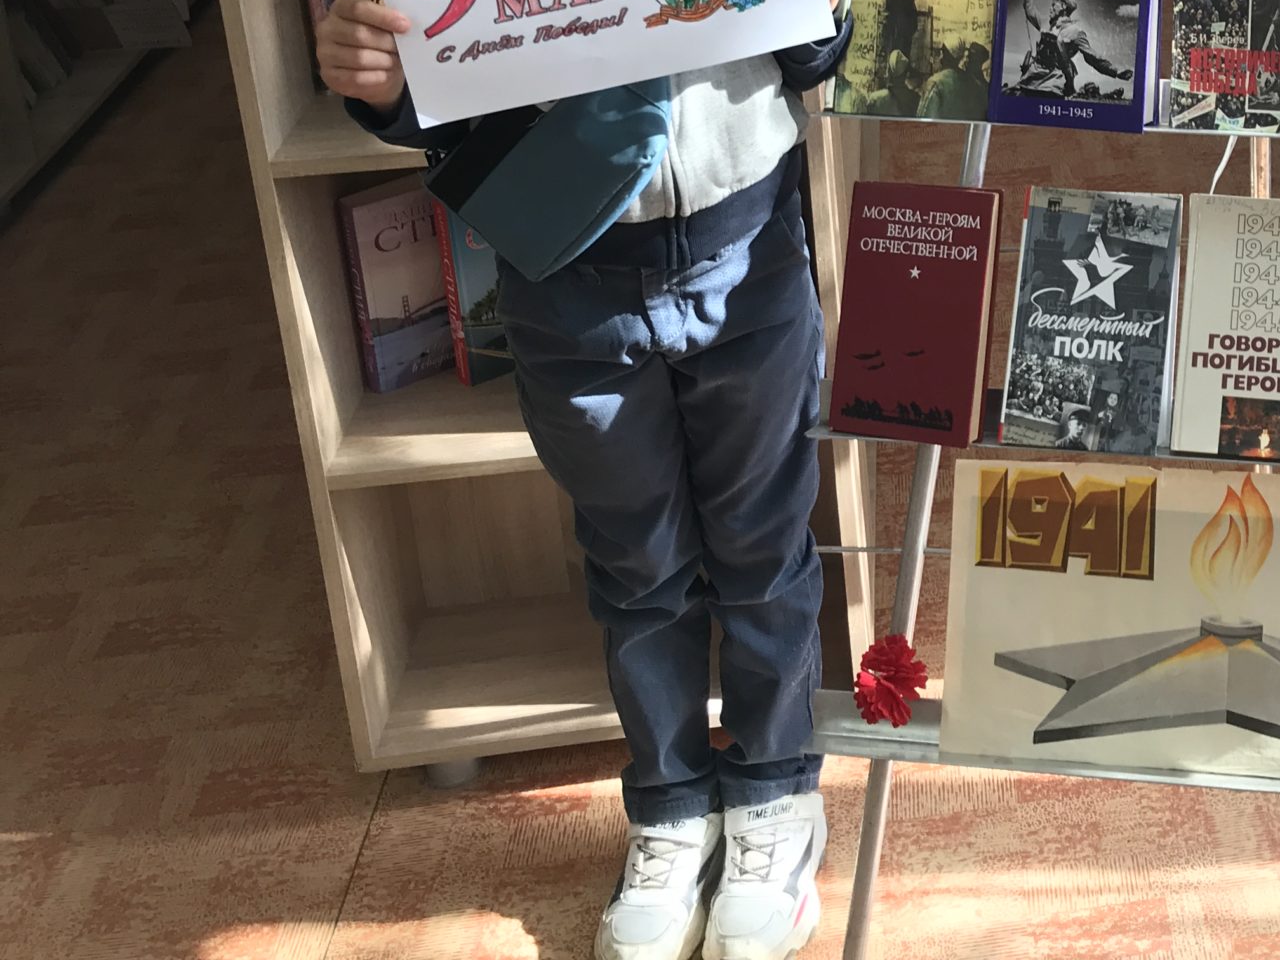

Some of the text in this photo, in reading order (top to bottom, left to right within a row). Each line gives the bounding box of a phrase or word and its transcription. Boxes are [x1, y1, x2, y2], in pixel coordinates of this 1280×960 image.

[533, 7, 628, 43] Победы!
[1189, 69, 1258, 96] ПОБЕДА
[862, 205, 981, 229] МОСКВА-ГЕРОЯМ
[887, 224, 953, 243] ВЕЛИКОЙ
[860, 238, 978, 261] ОТЕЧЕСТВЕННОЙ
[1053, 335, 1124, 363] ПОЛК
[974, 466, 1157, 581] 1941
